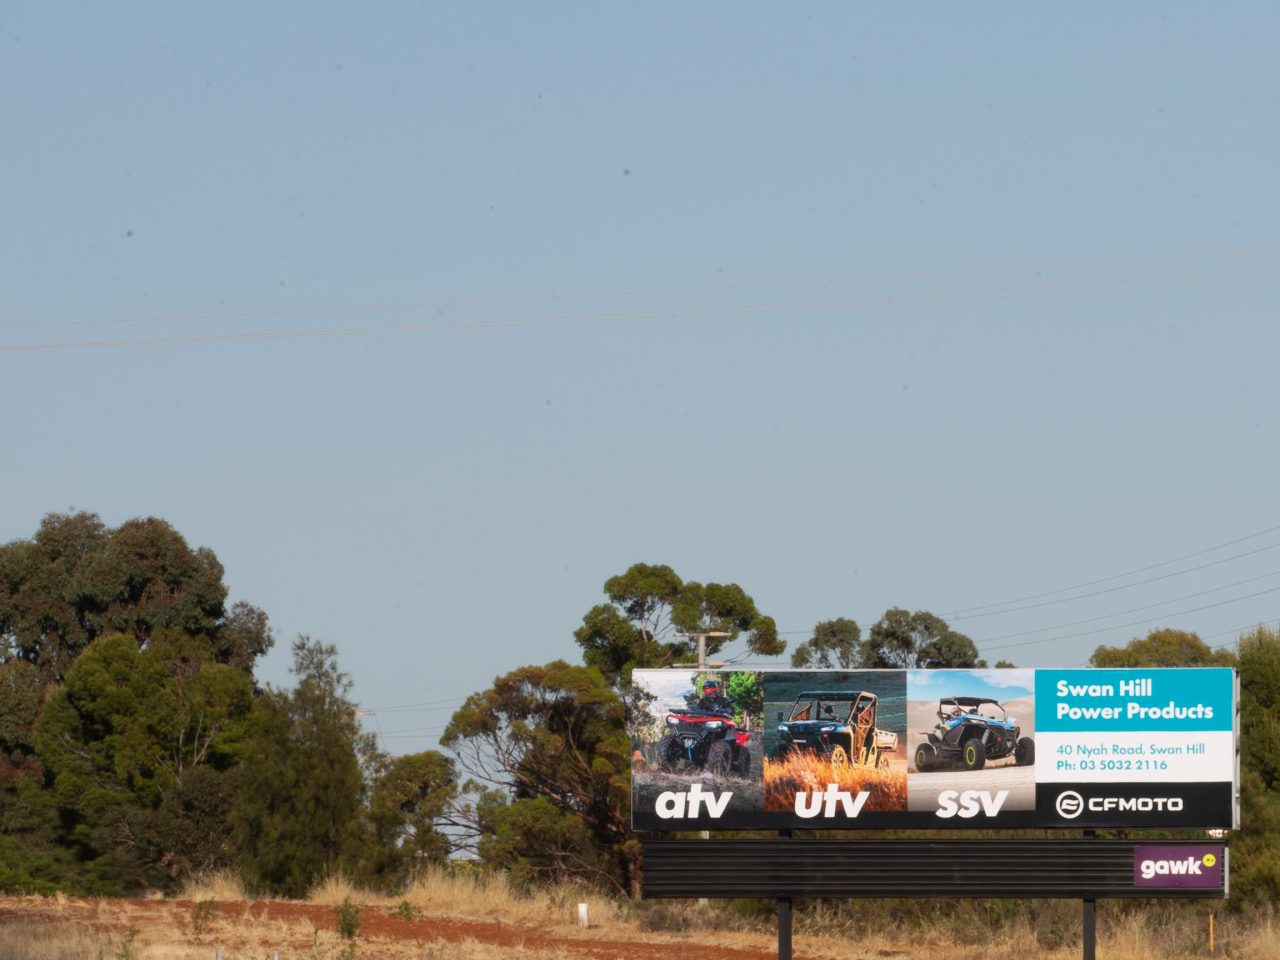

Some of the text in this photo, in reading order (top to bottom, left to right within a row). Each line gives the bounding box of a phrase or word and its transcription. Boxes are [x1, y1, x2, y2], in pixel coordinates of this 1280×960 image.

[1056, 678, 1152, 697] Swan Hill
[1056, 701, 1214, 720] Power Products
[1056, 743, 1205, 758] 40 Nyah Road, Swan Hill
[1056, 760, 1168, 771] Ph: 03 5032 2116
[655, 783, 733, 818] atv
[794, 783, 870, 818] utv
[1088, 797, 1184, 811] CFMOTO
[1140, 856, 1202, 879] gawk
